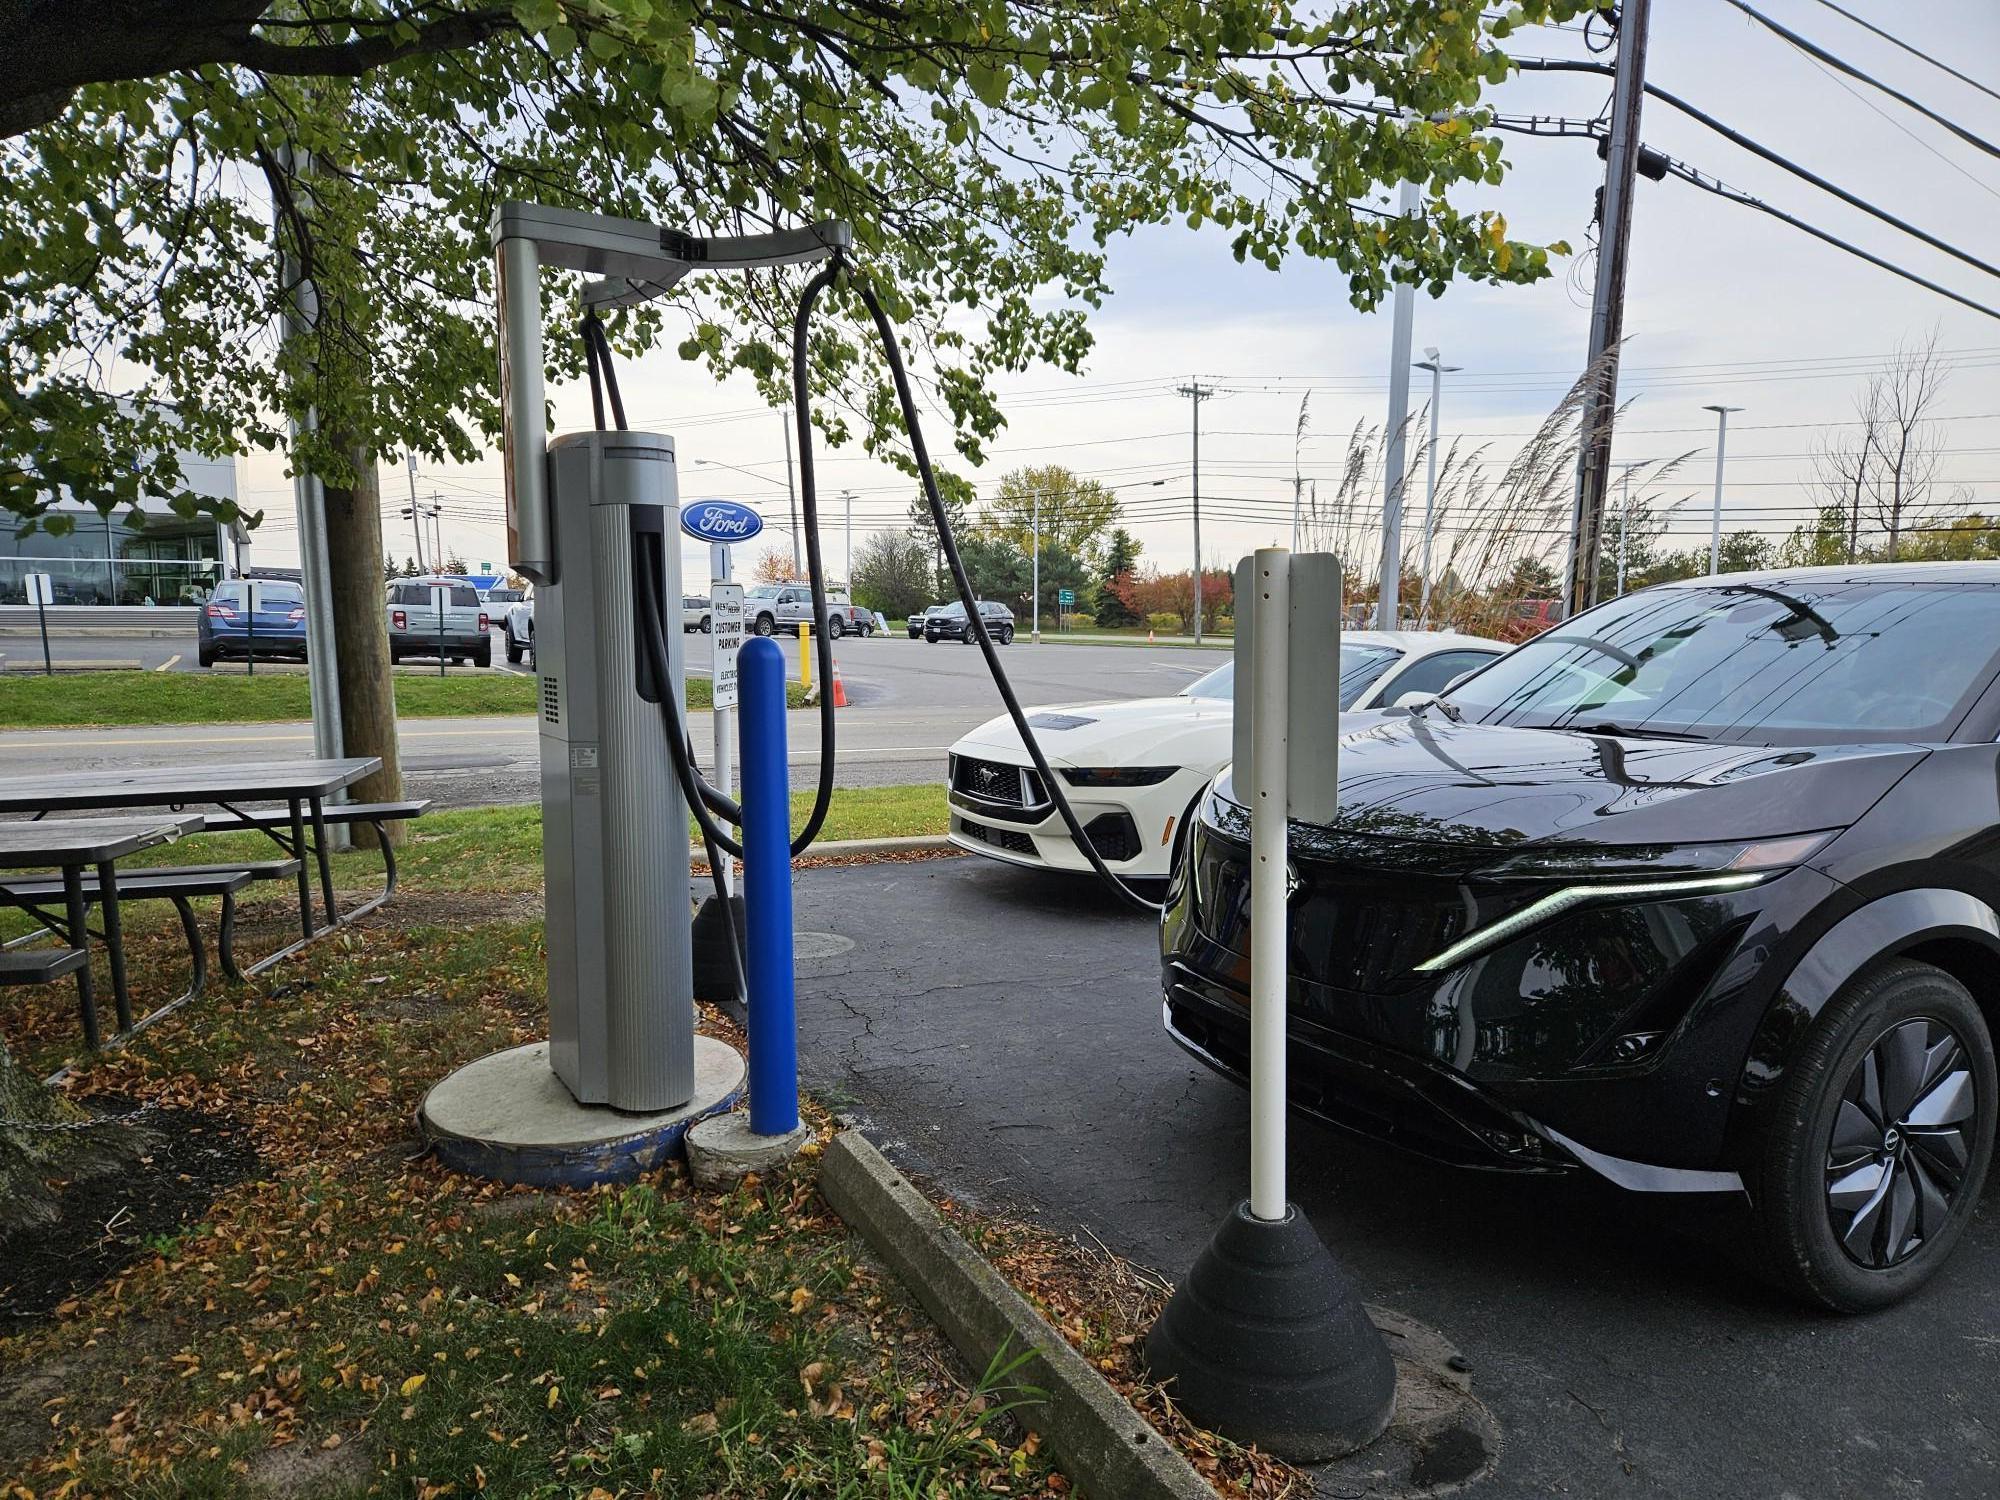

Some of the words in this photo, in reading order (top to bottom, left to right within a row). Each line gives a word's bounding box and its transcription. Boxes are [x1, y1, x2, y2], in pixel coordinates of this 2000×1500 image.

[699, 506, 748, 533] Ford
[715, 621, 741, 634] CUSTOMER
[718, 637, 740, 650] PARKING
